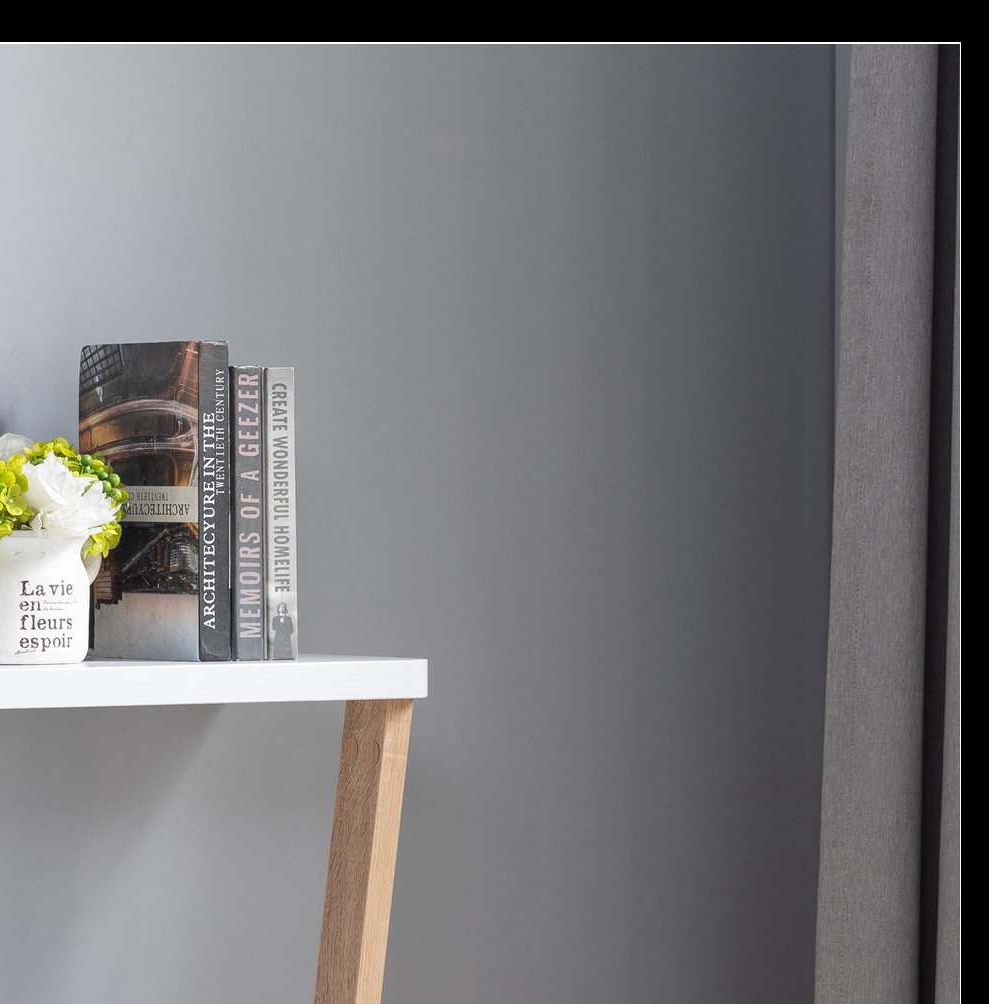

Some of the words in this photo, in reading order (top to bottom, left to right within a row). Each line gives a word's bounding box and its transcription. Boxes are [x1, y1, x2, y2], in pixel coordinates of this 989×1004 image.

[215, 368, 226, 422] CENTURY
[237, 373, 259, 457] GEEZER
[271, 383, 288, 431] CREATE
[203, 412, 216, 454] THE
[203, 455, 216, 477] IN
[215, 427, 226, 495] TWENTIETH
[239, 470, 260, 481] A
[272, 435, 289, 520] WONDERFUL
[122, 503, 190, 516] ARCHITECYUR
[239, 493, 260, 520] OF
[203, 481, 216, 629] ARCHITECYURE
[273, 525, 291, 592] HOMELIFE
[19, 580, 46, 596] La
[48, 580, 73, 596] vie
[19, 600, 41, 612] en
[238, 532, 262, 639] MEMOIRS
[19, 614, 73, 630] fleurs
[19, 633, 73, 652] espoir
